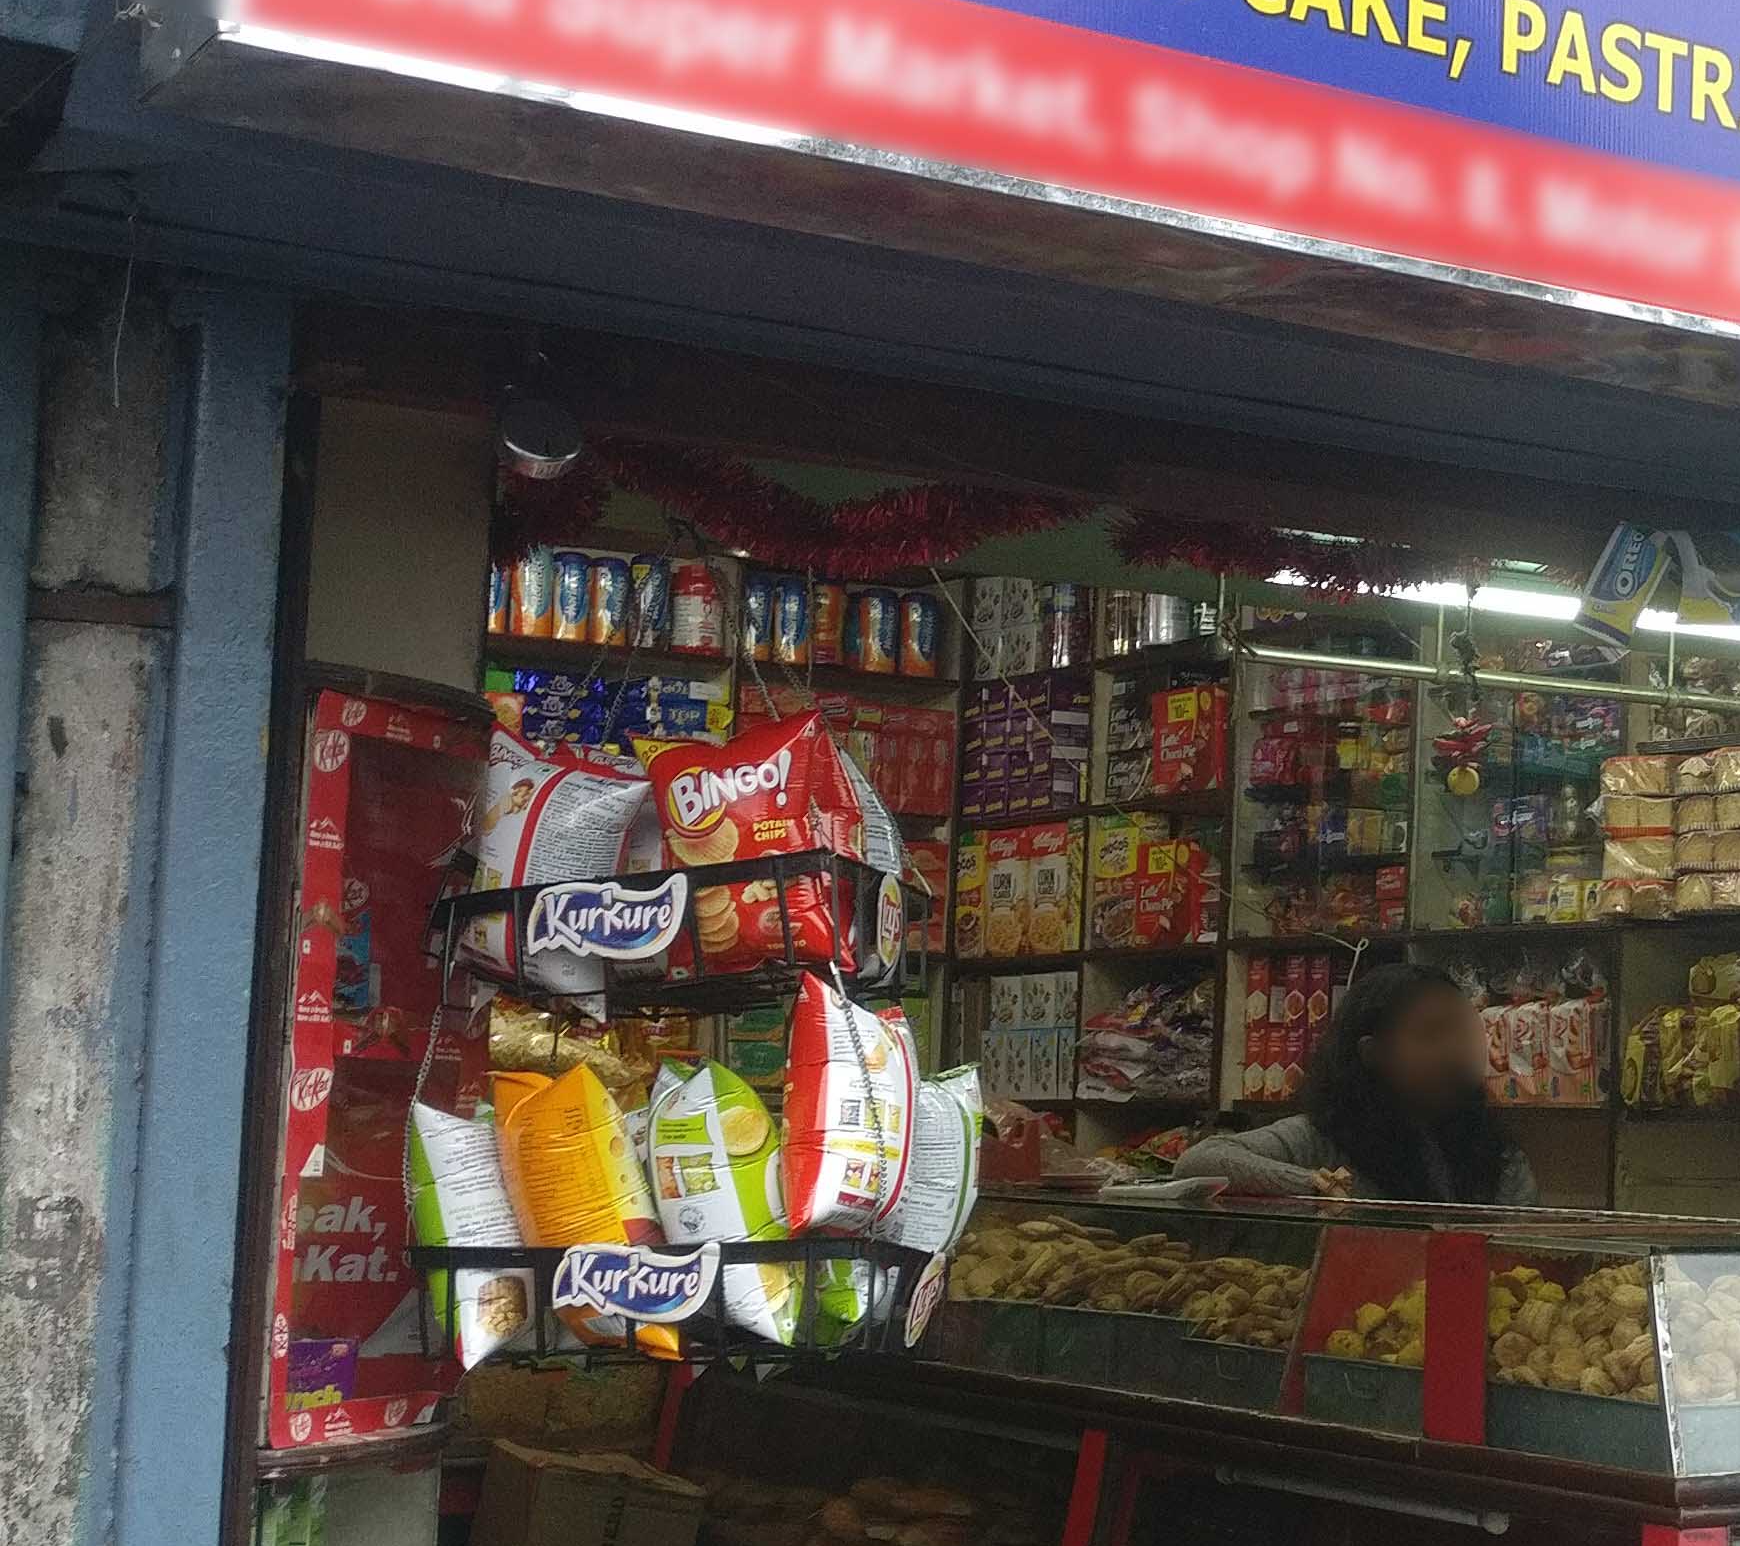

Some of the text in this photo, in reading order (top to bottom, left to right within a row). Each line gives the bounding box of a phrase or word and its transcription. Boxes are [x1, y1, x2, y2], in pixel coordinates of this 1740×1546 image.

[1614, 530, 1644, 598] OREO
[670, 749, 793, 828] BINGO!
[752, 818, 795, 833] POTATO
[753, 828, 787, 842] CHIPS
[542, 888, 673, 947] Kurkure
[570, 1251, 699, 1310] Kurkure
